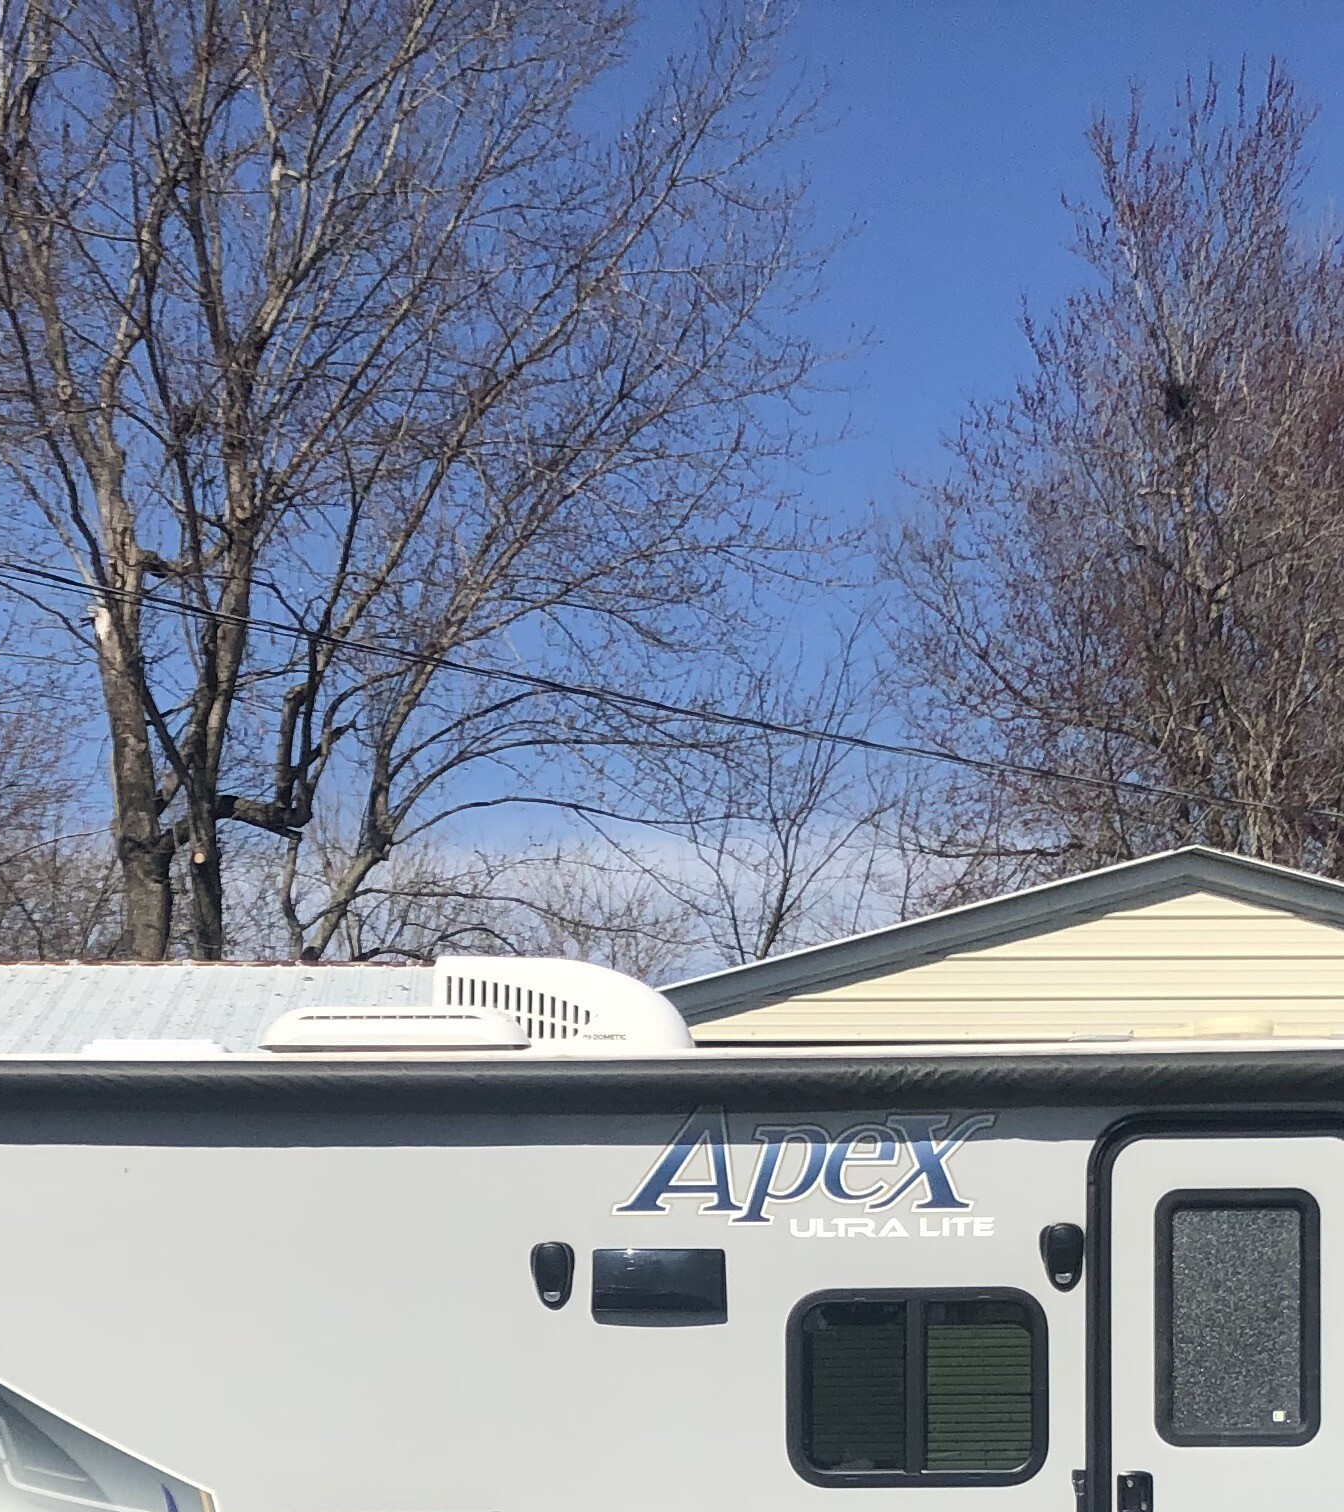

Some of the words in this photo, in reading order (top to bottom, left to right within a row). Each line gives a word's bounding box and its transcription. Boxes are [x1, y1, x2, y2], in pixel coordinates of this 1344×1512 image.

[612, 1104, 997, 1226] Apex
[789, 1217, 910, 1238] ULTRA
[920, 1217, 995, 1238] LITE
